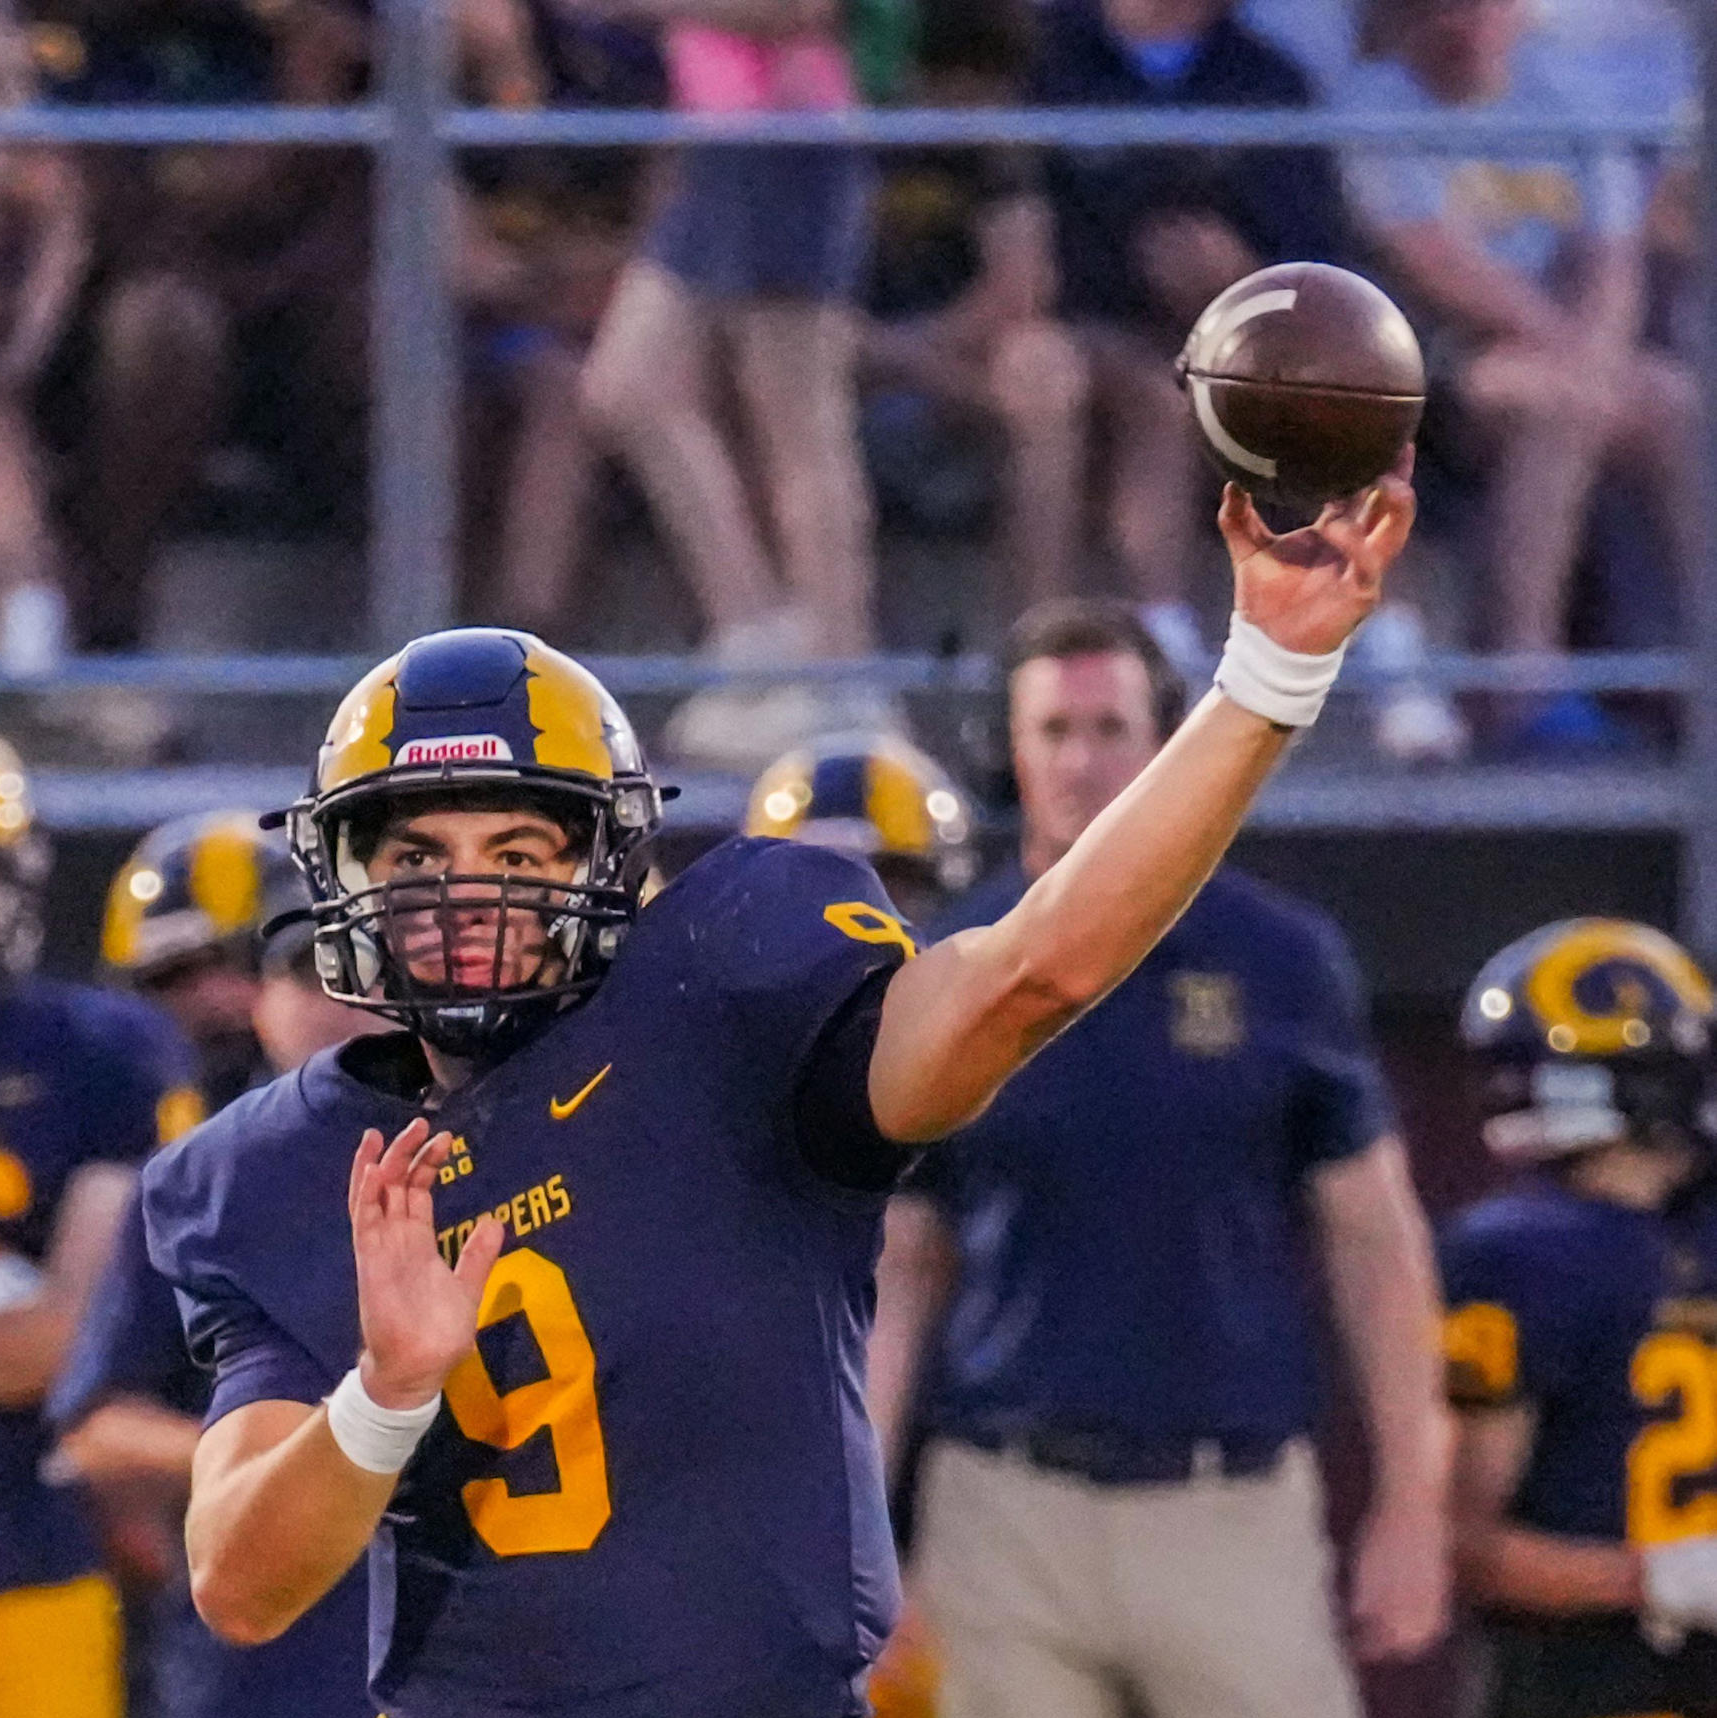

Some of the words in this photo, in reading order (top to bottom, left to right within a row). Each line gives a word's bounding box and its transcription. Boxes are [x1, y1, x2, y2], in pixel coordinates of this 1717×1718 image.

[407, 739, 497, 763] Riddell
[437, 1173, 572, 1268] TOPERS
[443, 1247, 612, 1558] 9
